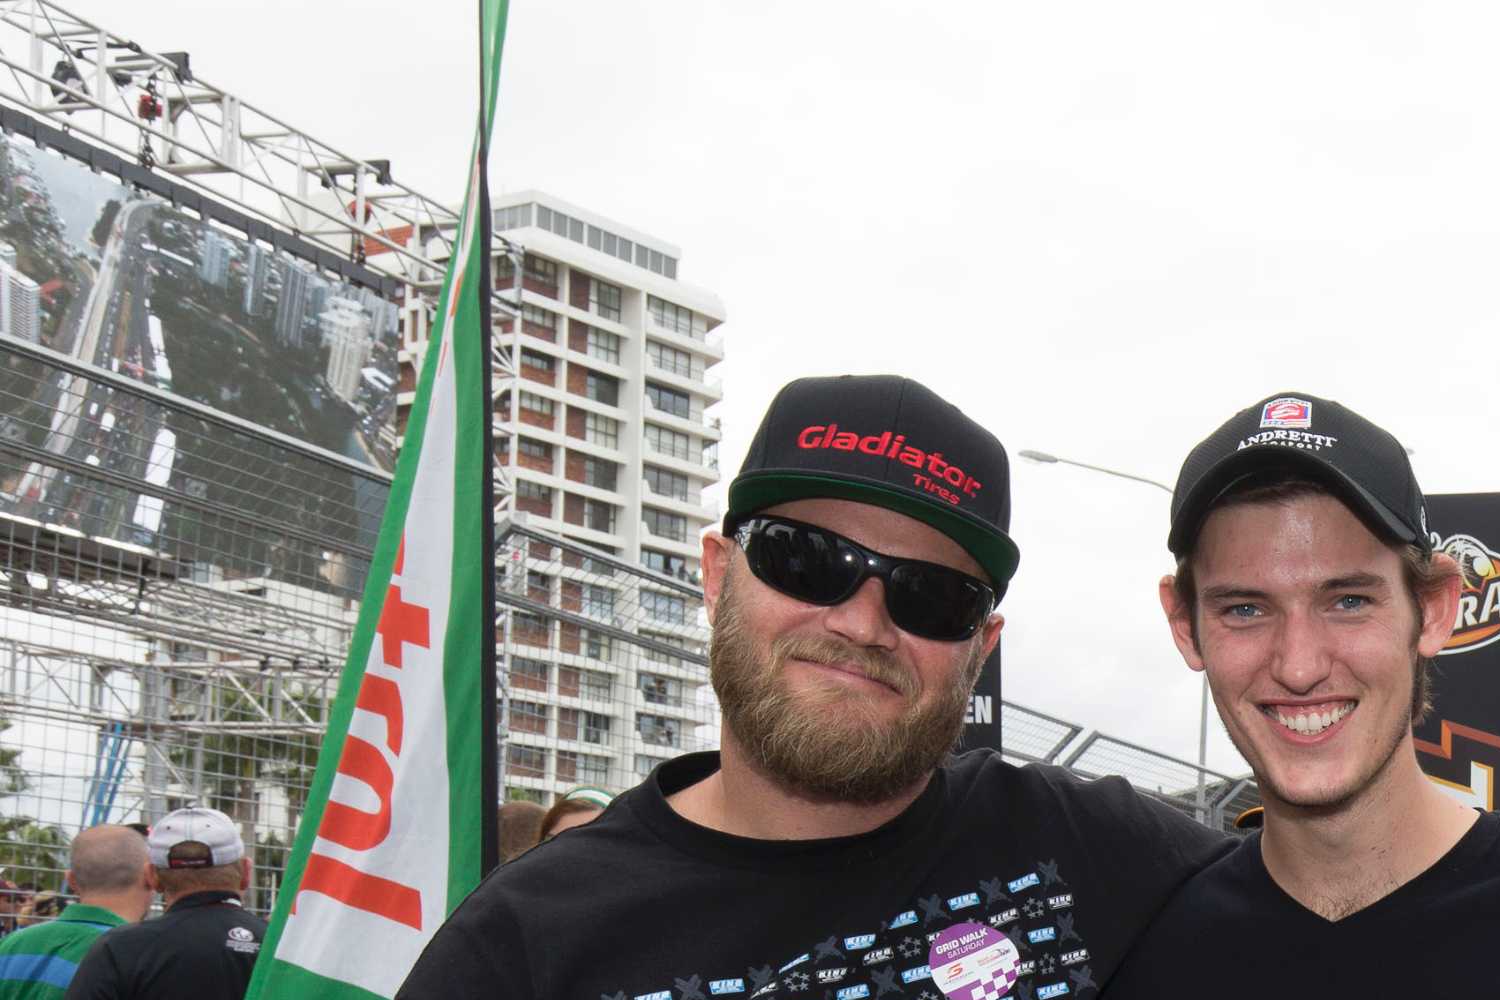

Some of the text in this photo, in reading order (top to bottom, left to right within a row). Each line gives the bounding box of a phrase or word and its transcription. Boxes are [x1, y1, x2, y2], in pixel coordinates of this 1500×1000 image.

[1237, 430, 1338, 451] ANDRETTI
[797, 424, 983, 497] Gladiator
[912, 473, 961, 506] Tires
[936, 939, 959, 955] GRID
[960, 928, 988, 945] WALK
[947, 939, 985, 959] SATURDAY
